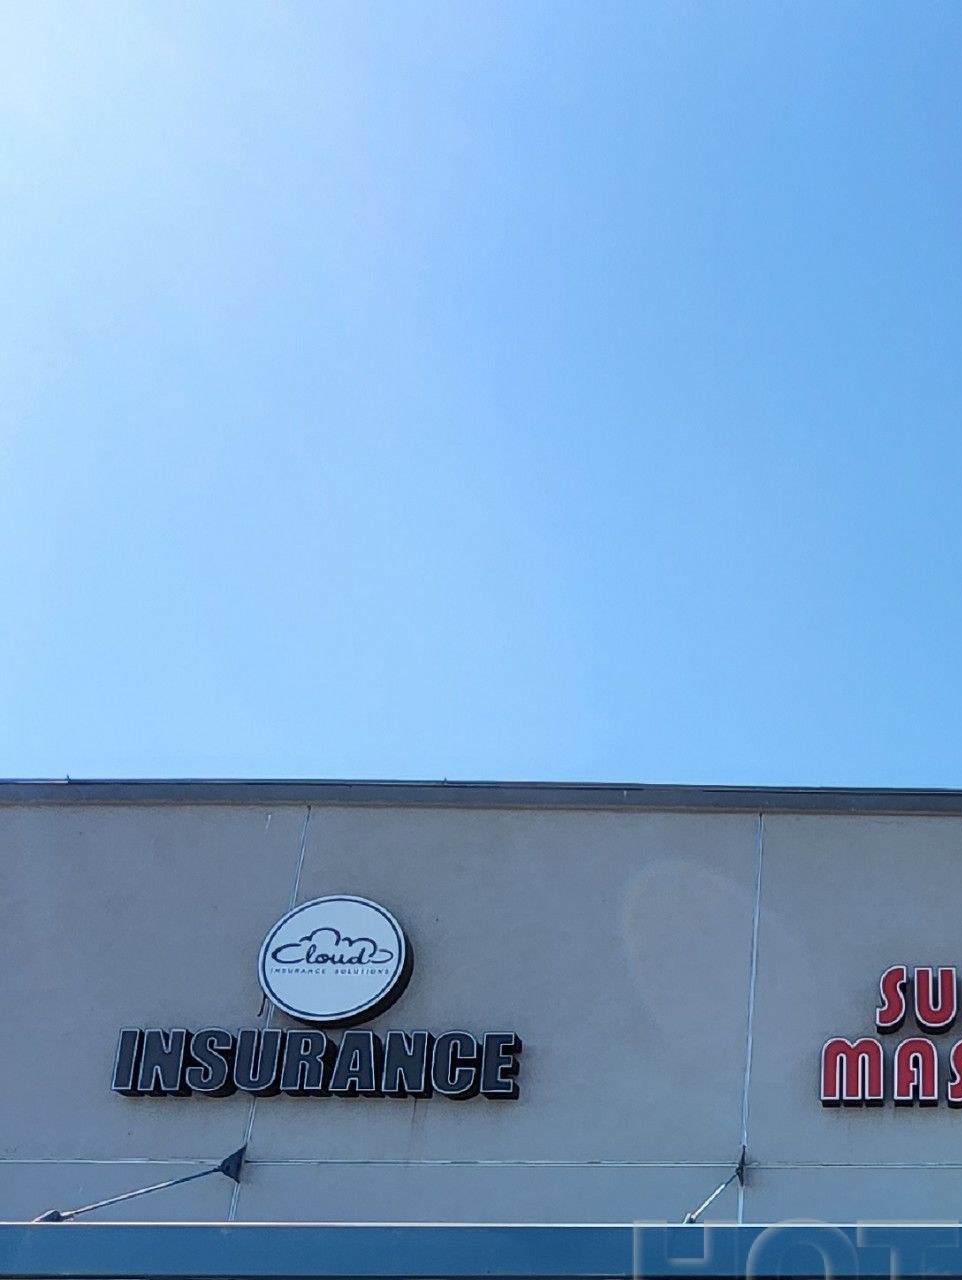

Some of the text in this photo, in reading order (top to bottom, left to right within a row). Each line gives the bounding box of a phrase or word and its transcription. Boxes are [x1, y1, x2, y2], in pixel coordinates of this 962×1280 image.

[271, 936, 386, 965] Cloud
[270, 967, 390, 976] INSURANCE SOLUTIONS
[112, 1027, 518, 1097] INSURANCE
